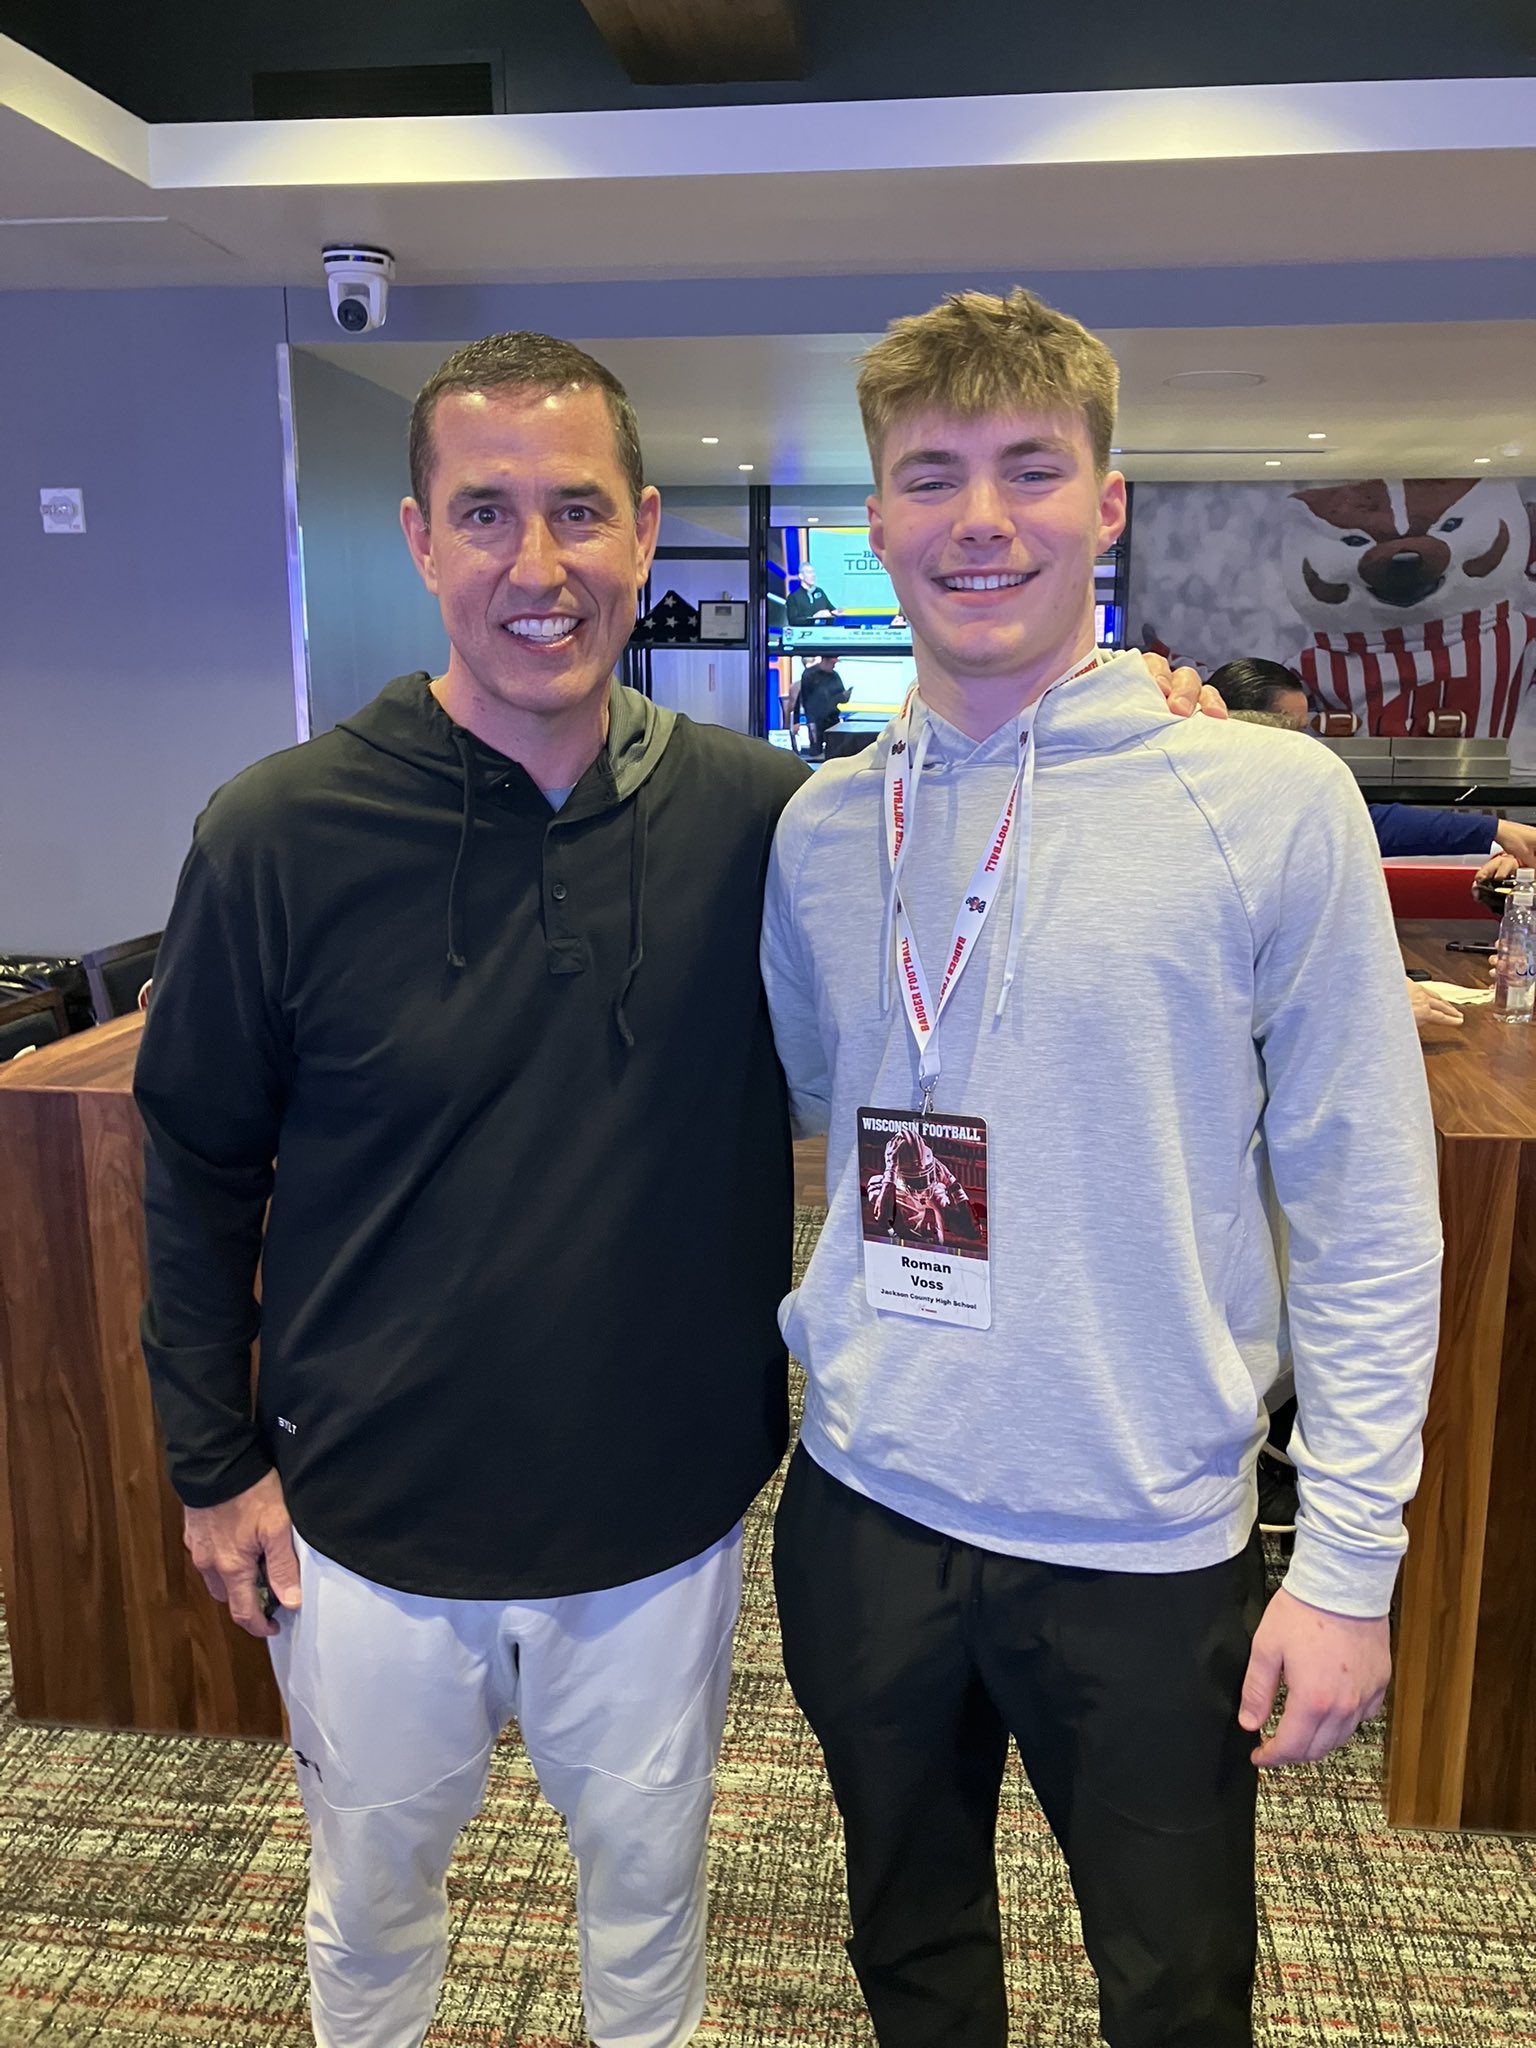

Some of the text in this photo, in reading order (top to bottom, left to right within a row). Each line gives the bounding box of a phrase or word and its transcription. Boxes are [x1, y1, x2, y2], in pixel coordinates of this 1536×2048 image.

[843, 559, 884, 570] TOD
[893, 778, 904, 829] FOOTBALL
[984, 819, 1011, 873] FOOTBALL
[947, 936, 967, 976] BADGER
[901, 937, 930, 1032] BADGER FOOTBALL
[862, 1117, 981, 1141] WISCONSIN FOOTBALL
[901, 1256, 951, 1274] Roman
[911, 1275, 944, 1290] Voss
[881, 1288, 977, 1310] Jackson County High School
